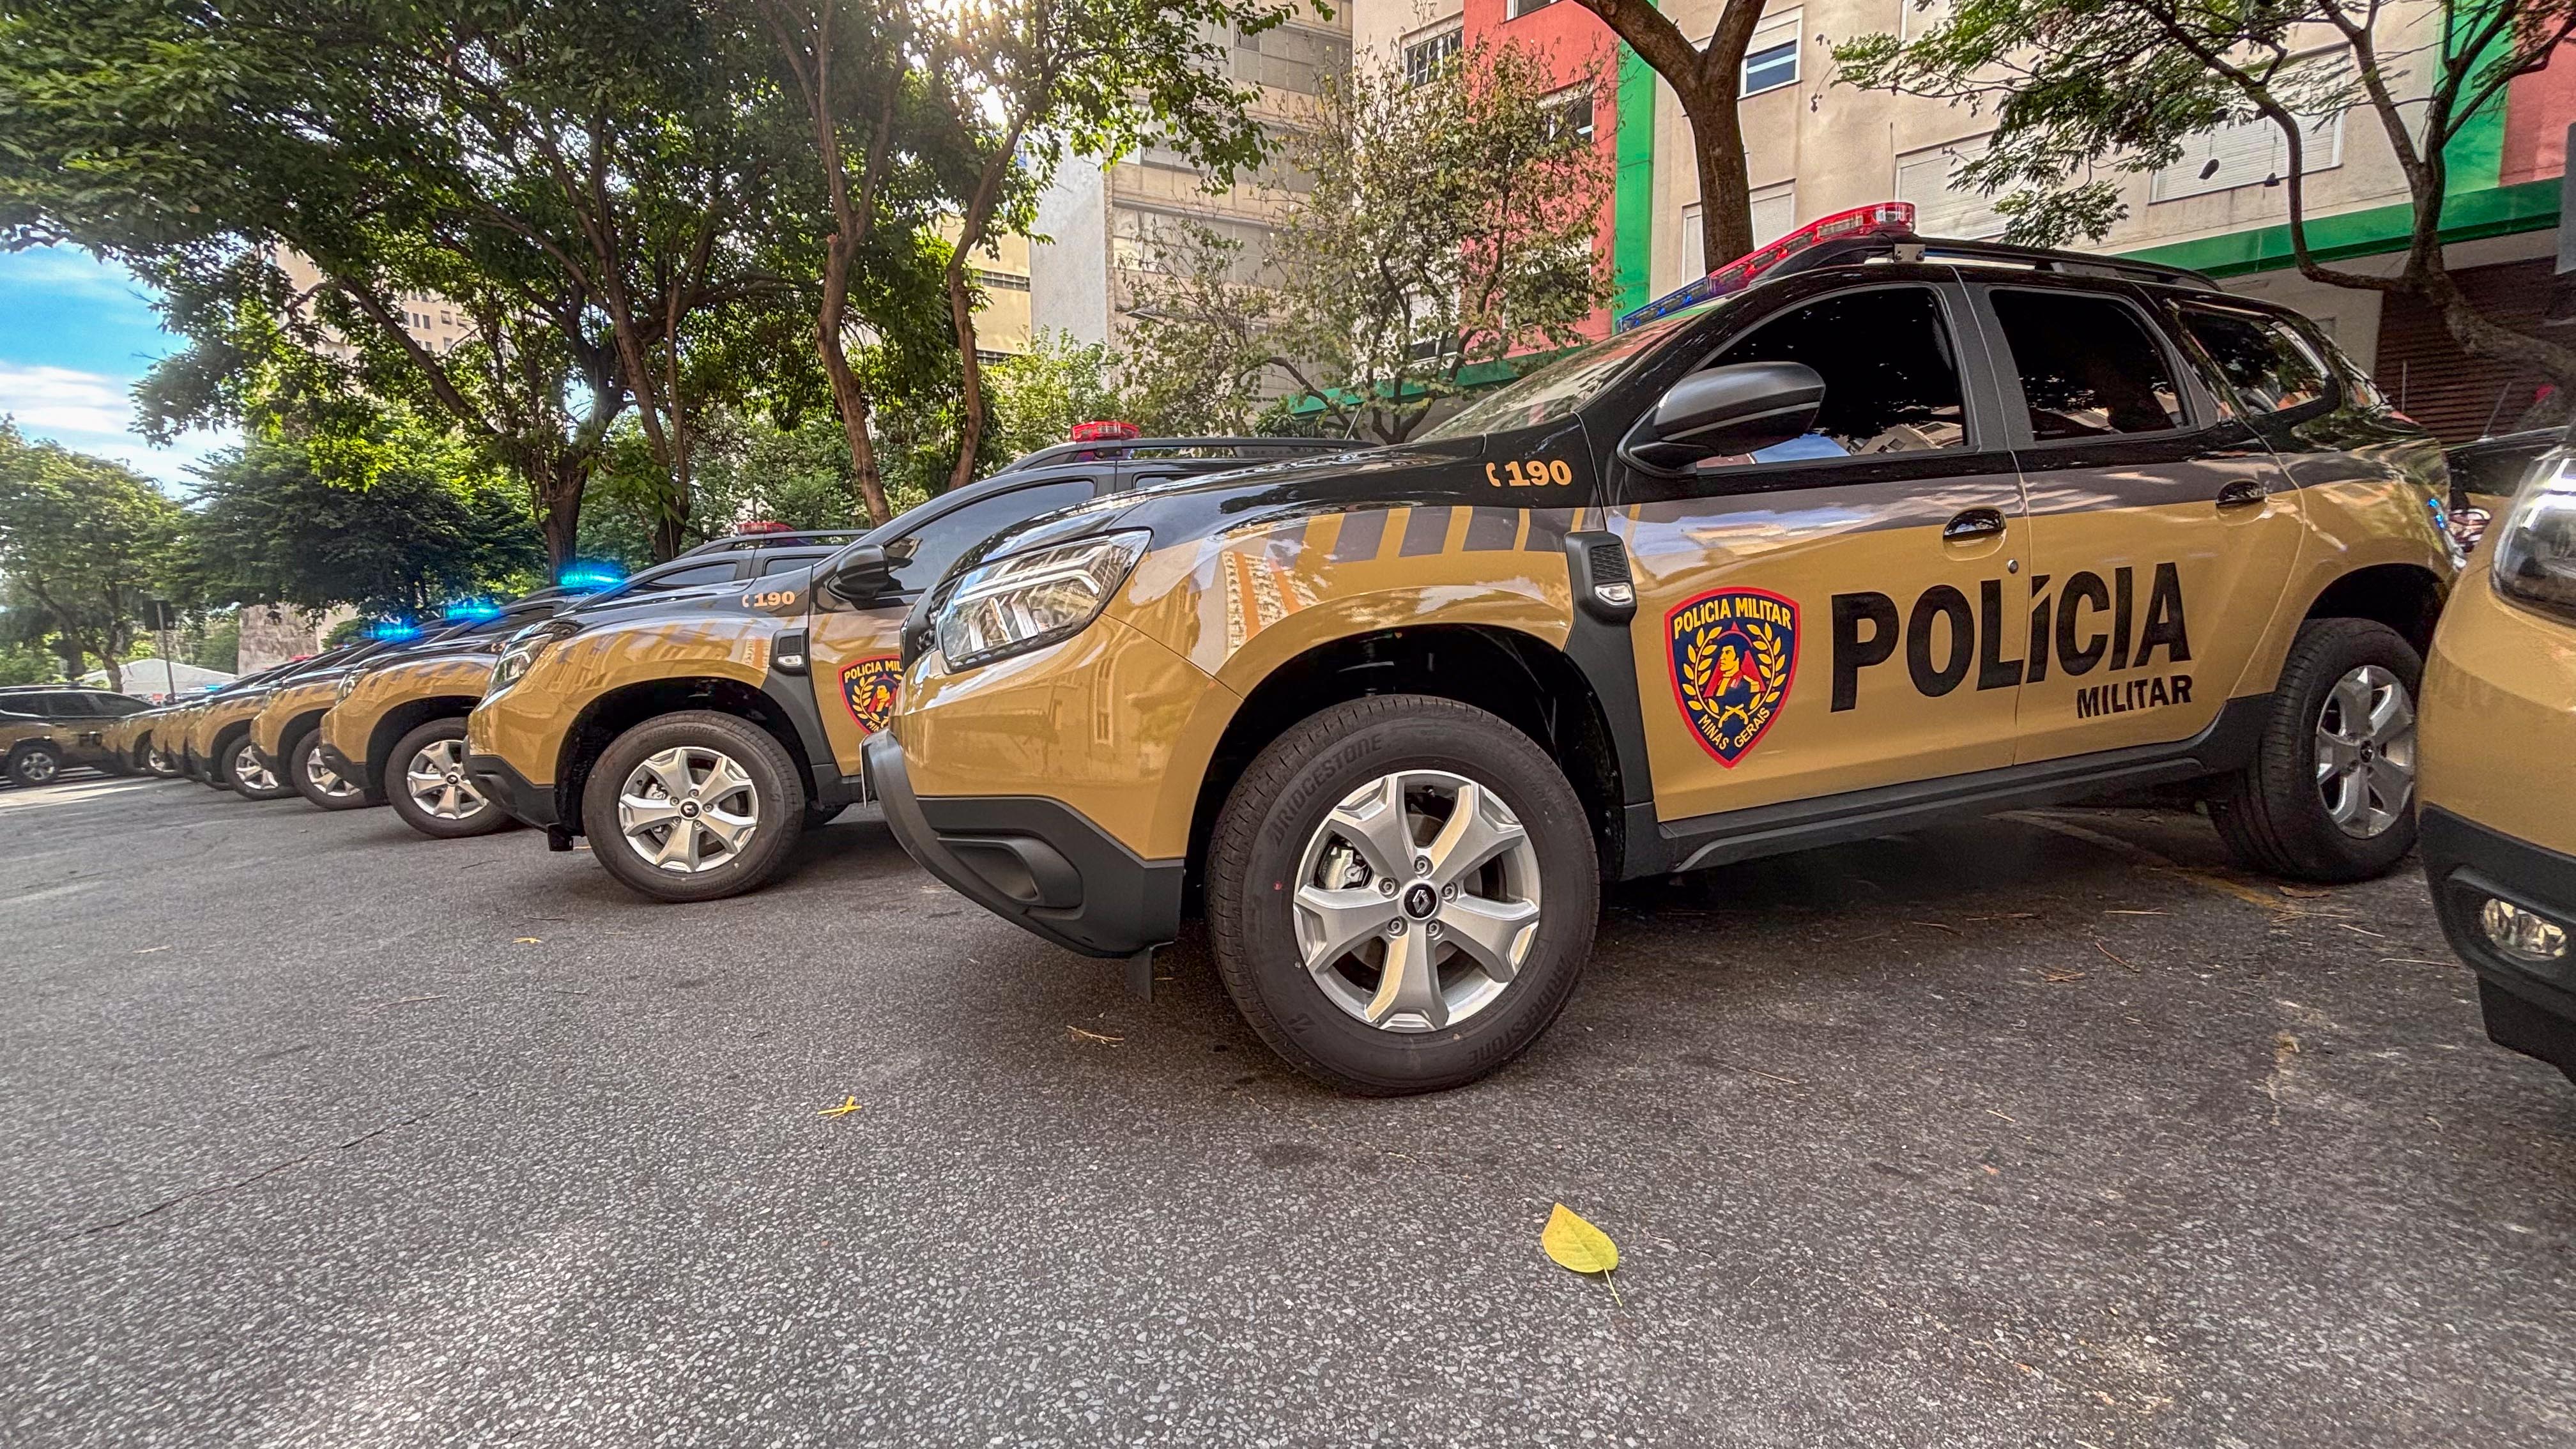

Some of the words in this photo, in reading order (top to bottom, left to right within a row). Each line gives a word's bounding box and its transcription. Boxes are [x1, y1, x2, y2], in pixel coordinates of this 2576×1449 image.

[1505, 460, 1572, 486] 190
[755, 591, 795, 607] 190
[1674, 599, 1731, 640] POLÍCIA
[1735, 597, 1792, 631] MILITAR
[1830, 562, 2193, 713] POLÍCIA
[2077, 675, 2193, 719] MILITAR
[1698, 714, 1729, 751] MINAS
[1733, 707, 1770, 749] GERAIS
